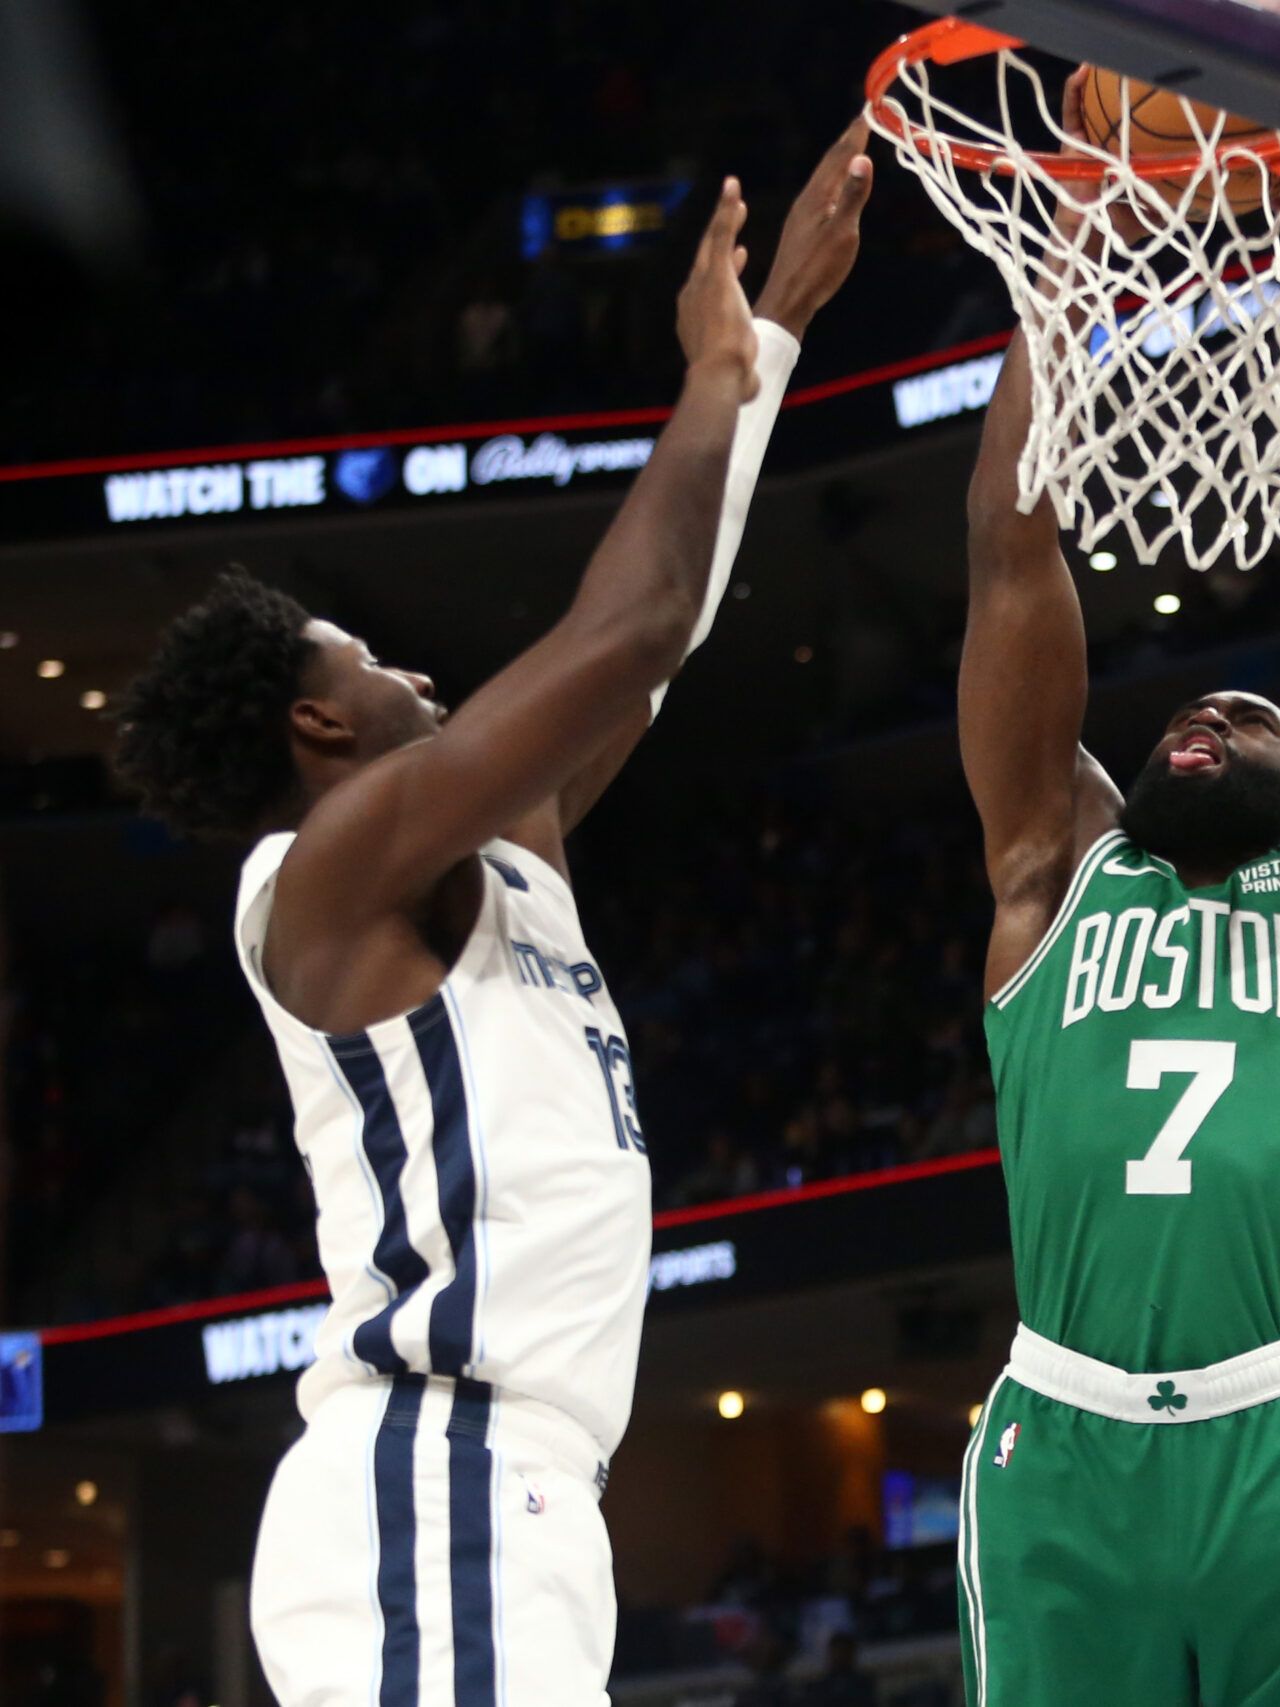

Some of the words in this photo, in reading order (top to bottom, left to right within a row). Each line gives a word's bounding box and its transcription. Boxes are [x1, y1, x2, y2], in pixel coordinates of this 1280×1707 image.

[104, 462, 244, 523] WATCH
[246, 454, 326, 510] THE
[403, 442, 468, 496] ON
[584, 1025, 648, 1153] 13
[1126, 1039, 1236, 1195] 7
